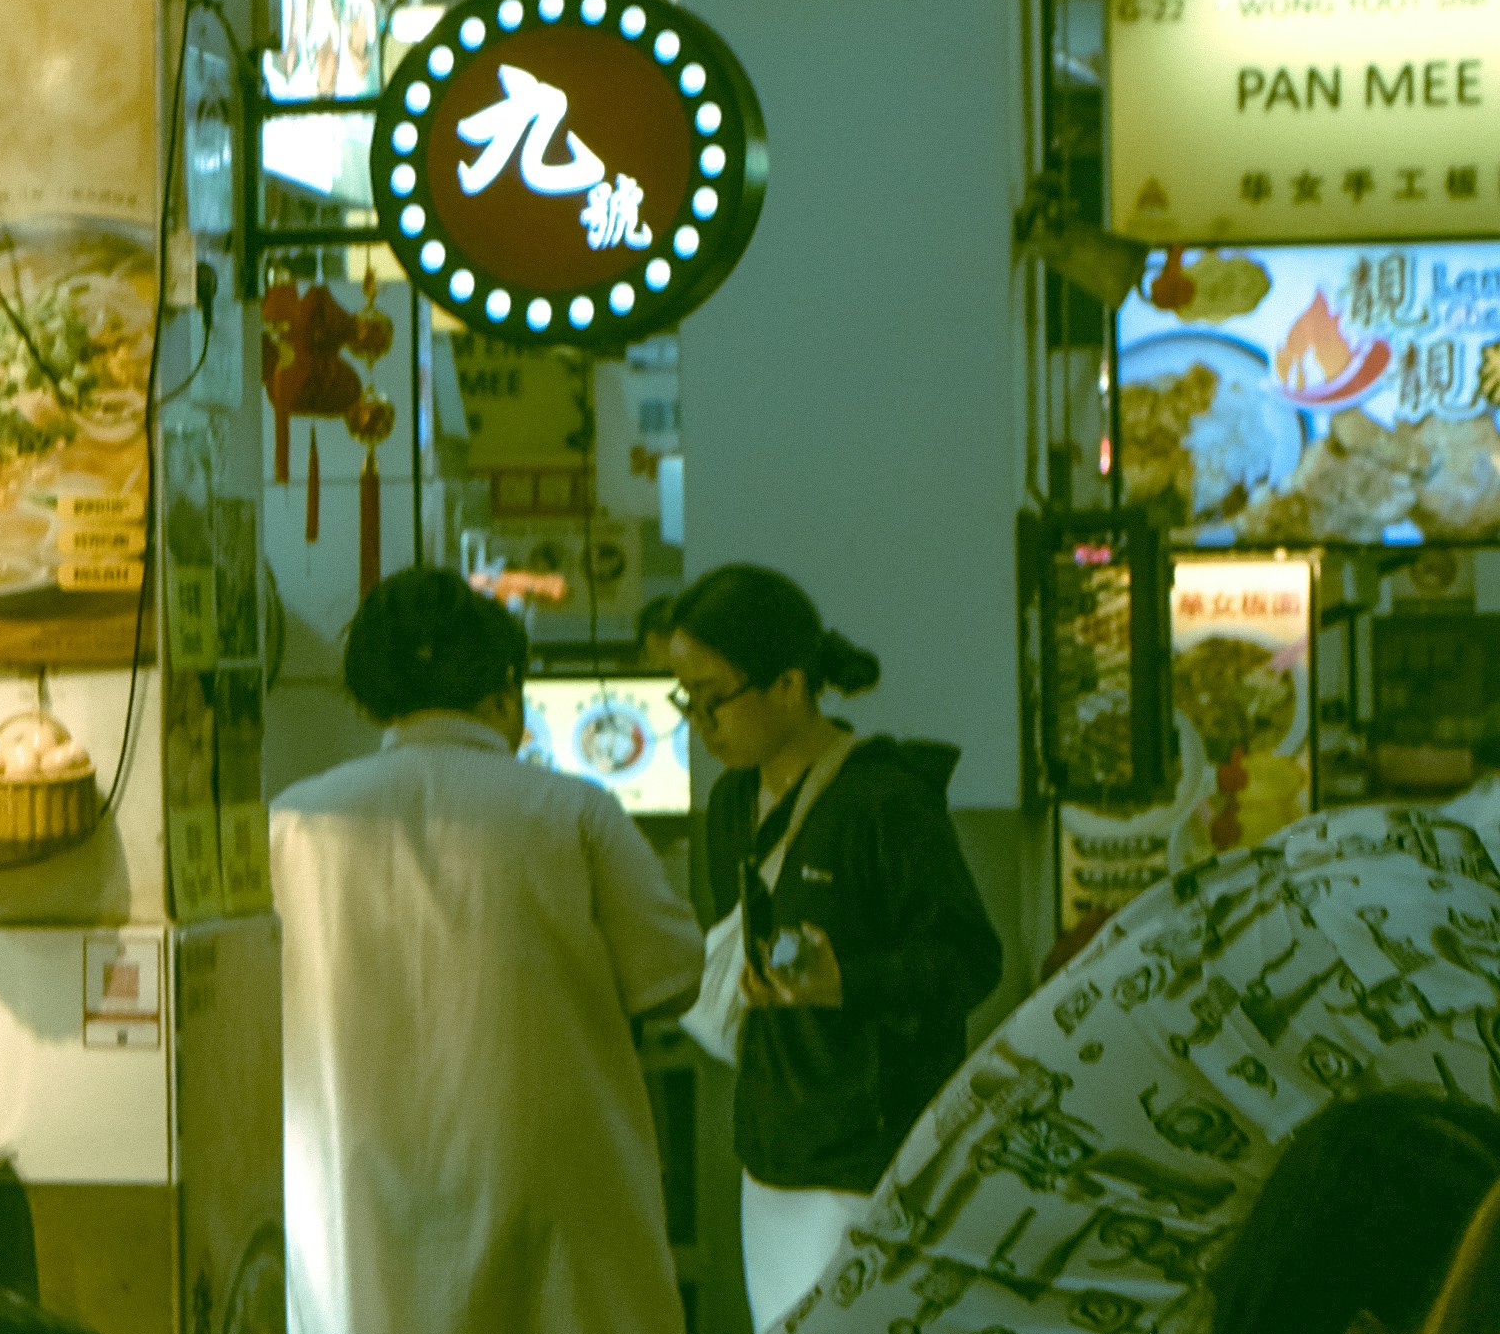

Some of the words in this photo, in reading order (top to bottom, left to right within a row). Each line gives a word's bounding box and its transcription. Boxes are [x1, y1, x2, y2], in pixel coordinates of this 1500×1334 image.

[1236, 63, 1343, 113] PAN
[1364, 57, 1483, 110] MEE
[457, 64, 654, 252] 九號
